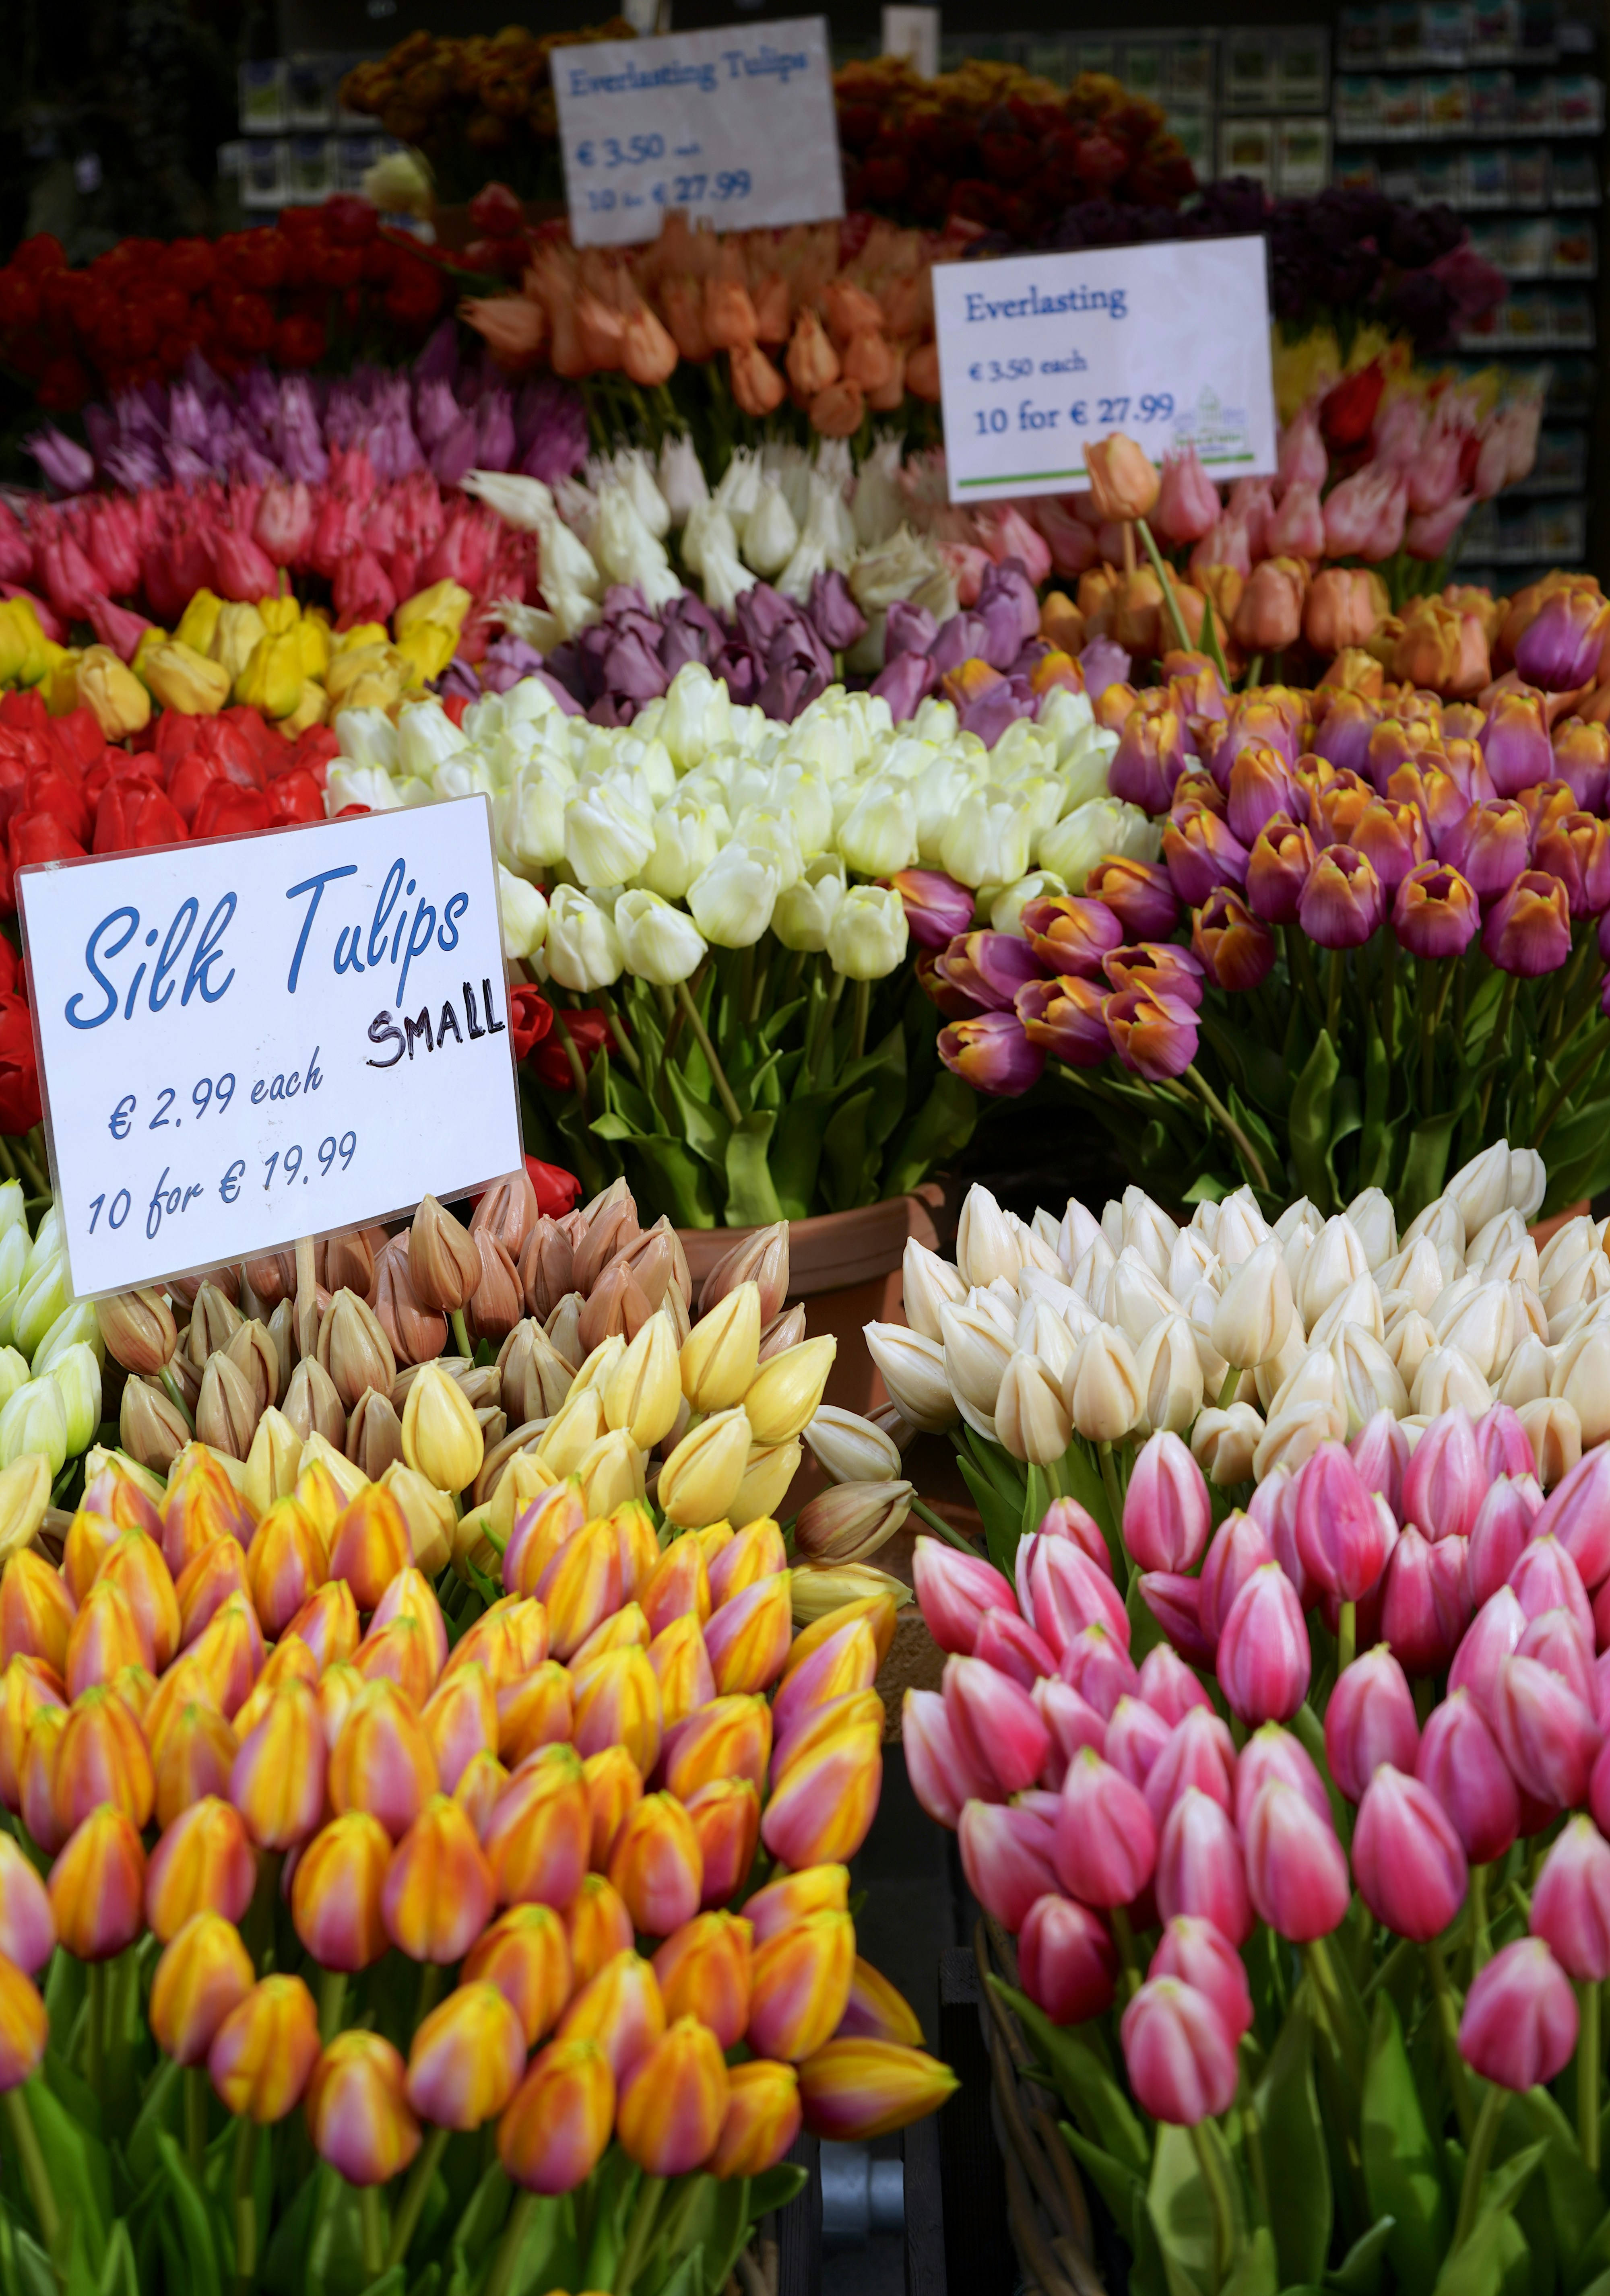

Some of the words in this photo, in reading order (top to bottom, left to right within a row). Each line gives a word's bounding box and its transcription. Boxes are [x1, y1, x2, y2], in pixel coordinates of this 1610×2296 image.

[569, 60, 718, 97] Everlasting
[722, 45, 809, 83] Tulips
[576, 140, 595, 167] €
[603, 132, 665, 168] 3.50
[673, 169, 751, 202] 27.99
[965, 284, 1128, 321] Everlasting
[968, 362, 982, 381] €
[988, 357, 1033, 381] 3.50
[1040, 350, 1088, 375] each
[975, 408, 1008, 435] 10
[1018, 399, 1060, 431] for
[1069, 400, 1088, 425] €
[1098, 391, 1175, 423] 27.99
[64, 891, 237, 1029] Silk
[286, 857, 469, 1008] Tulips
[365, 978, 506, 1068] SMALL
[108, 1094, 136, 1140] €
[149, 1073, 236, 1129] 2.99
[250, 1046, 323, 1105] each
[88, 1188, 131, 1235] 10
[146, 1167, 204, 1240] for
[219, 1159, 245, 1203] €
[263, 1131, 357, 1191] 19.99
